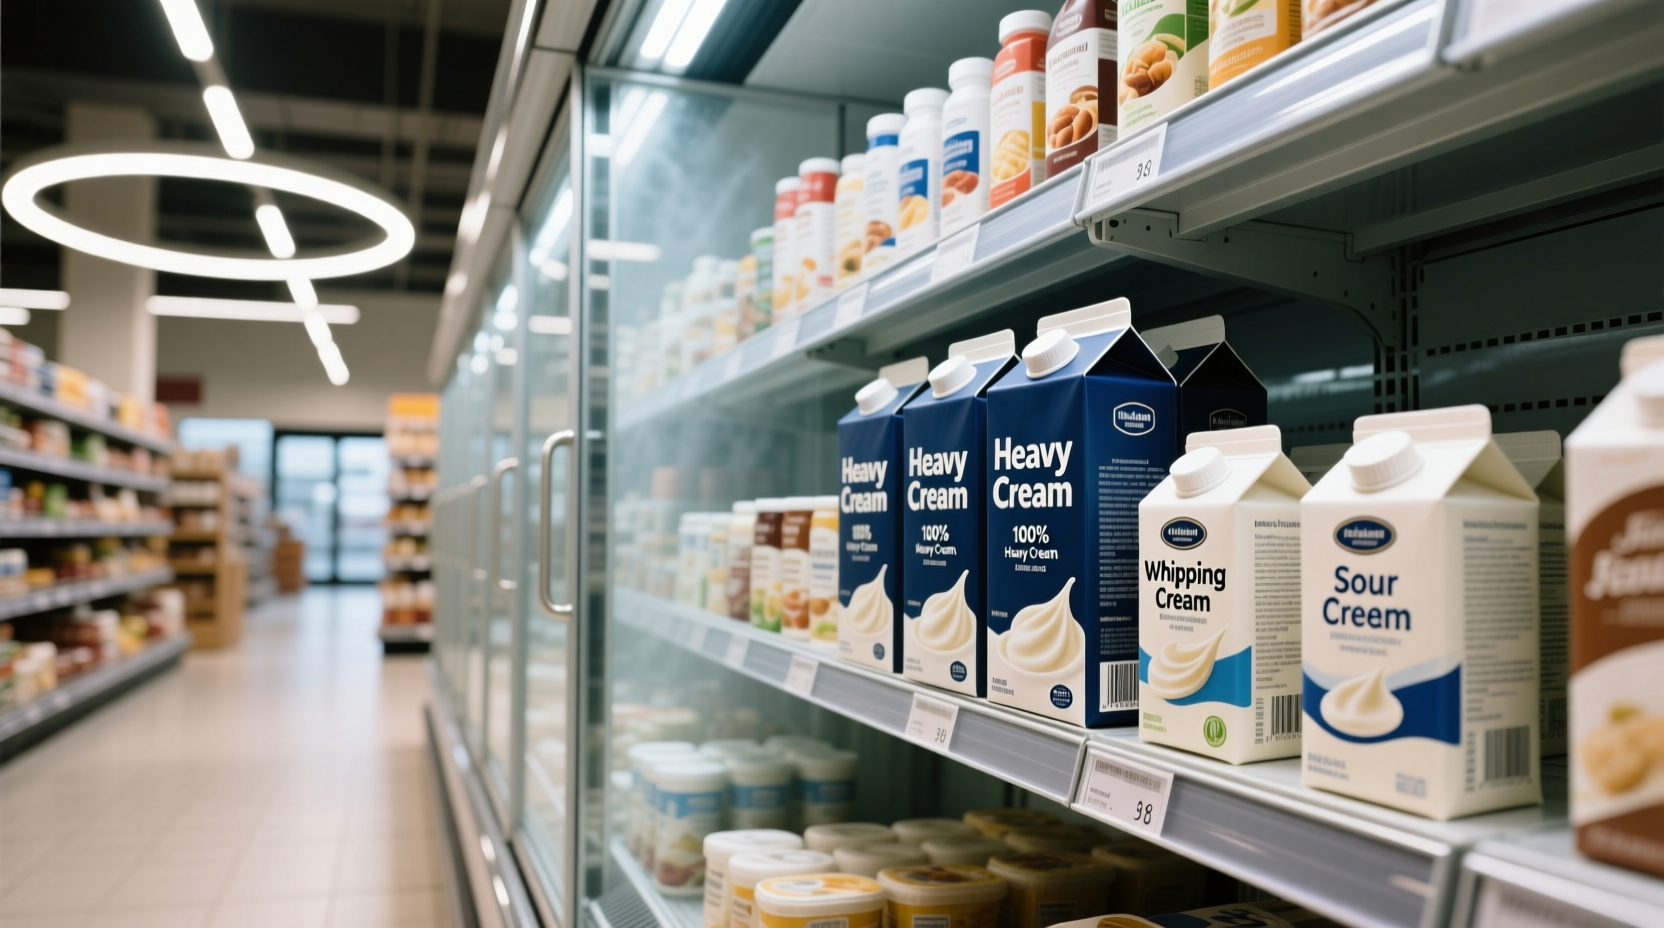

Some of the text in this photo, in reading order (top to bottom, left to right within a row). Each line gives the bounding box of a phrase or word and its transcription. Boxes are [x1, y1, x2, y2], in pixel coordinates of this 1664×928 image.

[841, 456, 888, 489] Heavy
[909, 447, 968, 482] Heavy
[994, 437, 1073, 477] Heavy
[841, 486, 888, 513] Cream
[908, 480, 968, 511] Cream
[992, 476, 1073, 509] Cream
[921, 524, 949, 541] 100%
[1012, 525, 1050, 543] 100%
[1144, 559, 1226, 591] Whipping
[1334, 565, 1399, 596] Sour
[1155, 587, 1211, 612] Cream
[1322, 597, 1411, 632] Creem
[1133, 800, 1153, 825] 98
